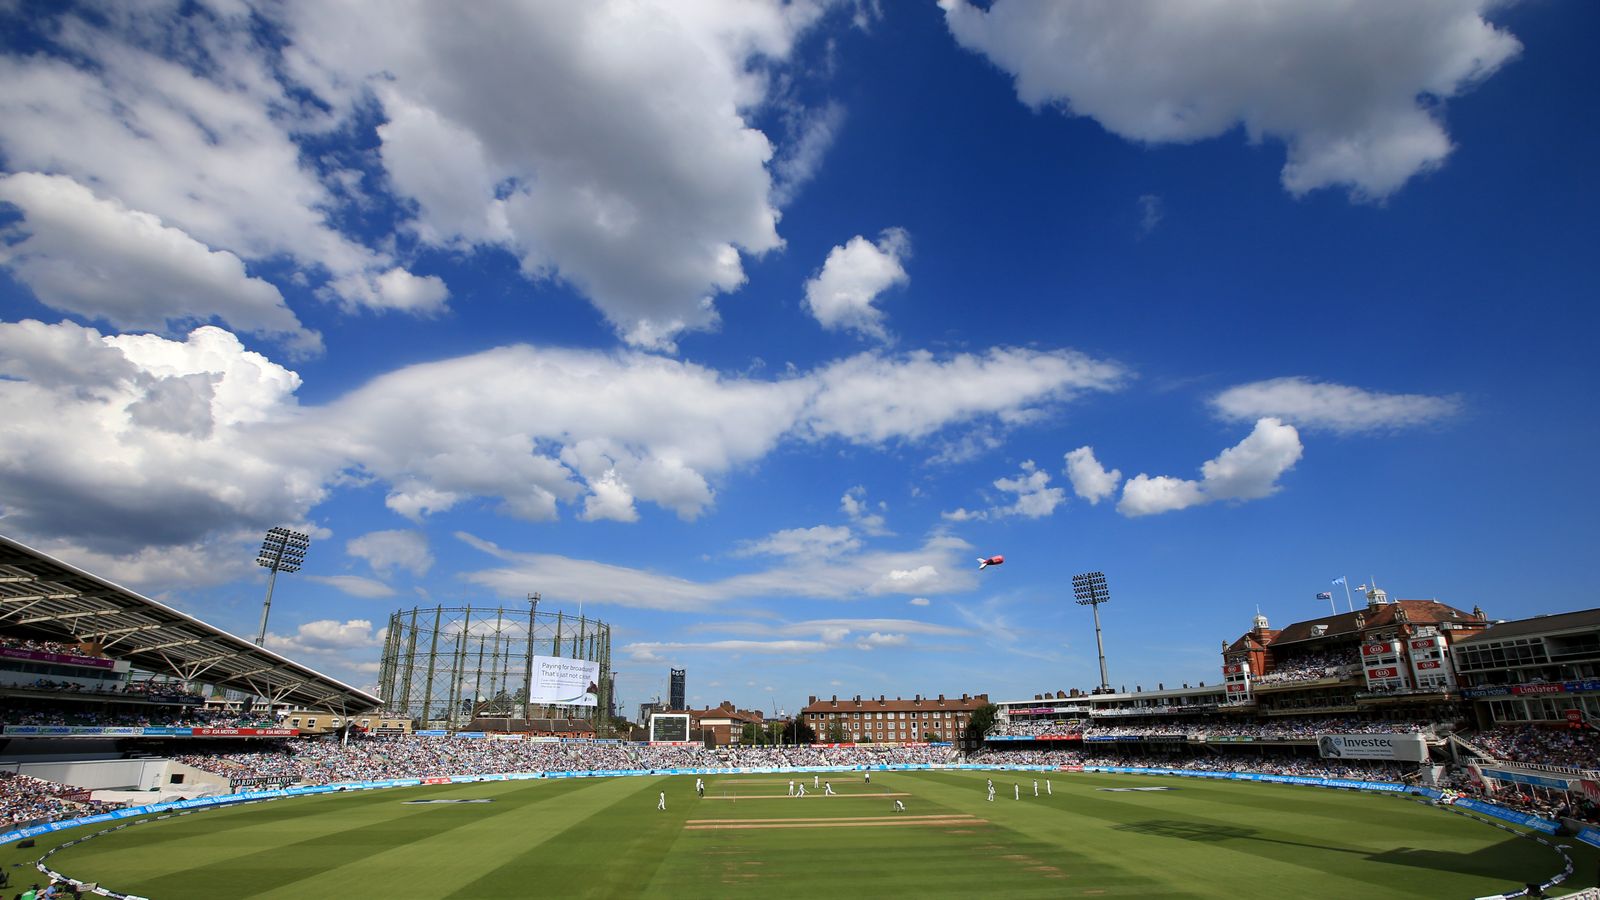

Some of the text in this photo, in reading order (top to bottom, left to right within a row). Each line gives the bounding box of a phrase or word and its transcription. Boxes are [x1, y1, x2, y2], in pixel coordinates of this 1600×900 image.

[541, 662, 561, 670] Paying
[1520, 685, 1559, 694] Linklaters
[4, 726, 37, 734] Lycamobile
[103, 727, 132, 735] Lycamobile
[1343, 737, 1393, 747] Investec
[1293, 777, 1323, 785] Investec
[1328, 779, 1361, 788] Investec
[1366, 782, 1404, 792] Investec
[250, 790, 279, 798] Investec
[151, 801, 182, 812] Investec
